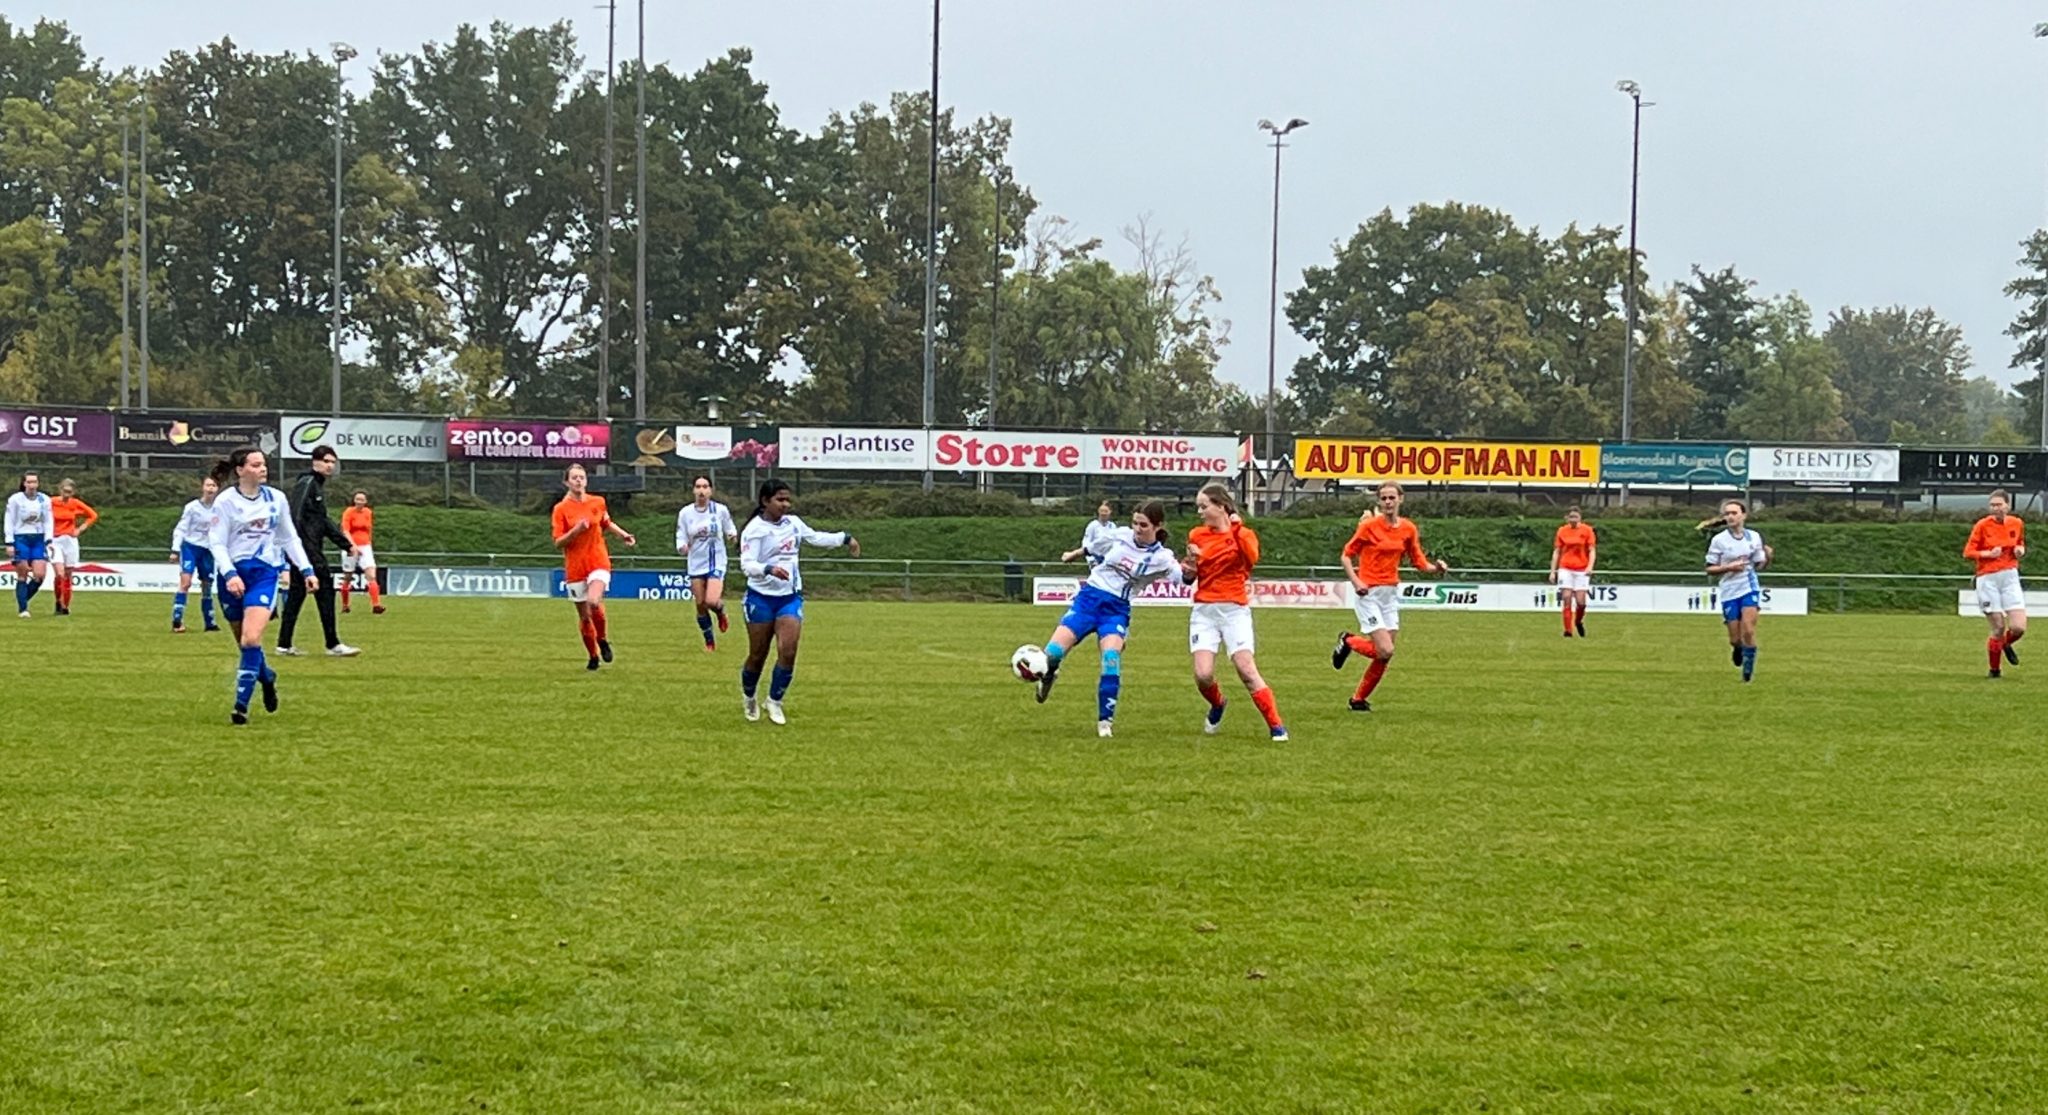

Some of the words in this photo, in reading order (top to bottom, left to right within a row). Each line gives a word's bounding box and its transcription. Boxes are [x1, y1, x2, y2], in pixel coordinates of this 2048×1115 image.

[23, 416, 78, 437] GIST
[118, 426, 168, 441] Bunnik
[191, 427, 250, 442] Creations
[336, 433, 353, 446] DE
[451, 428, 534, 446] zentoo
[822, 434, 915, 454] plantise
[1102, 438, 1196, 454] WONING-
[546, 446, 607, 459] COLLECTIVE
[935, 434, 1080, 468] Storre
[1773, 449, 1873, 470] STEENTJES
[1100, 456, 1227, 473] INRICHTING
[1305, 445, 1590, 478] AUTOHOFMAN.NL
[1938, 453, 2017, 469] LINDE
[430, 569, 532, 593] Vermin
[639, 588, 661, 600] no
[1403, 585, 1432, 597] der
[1435, 584, 1479, 604] Sluis
